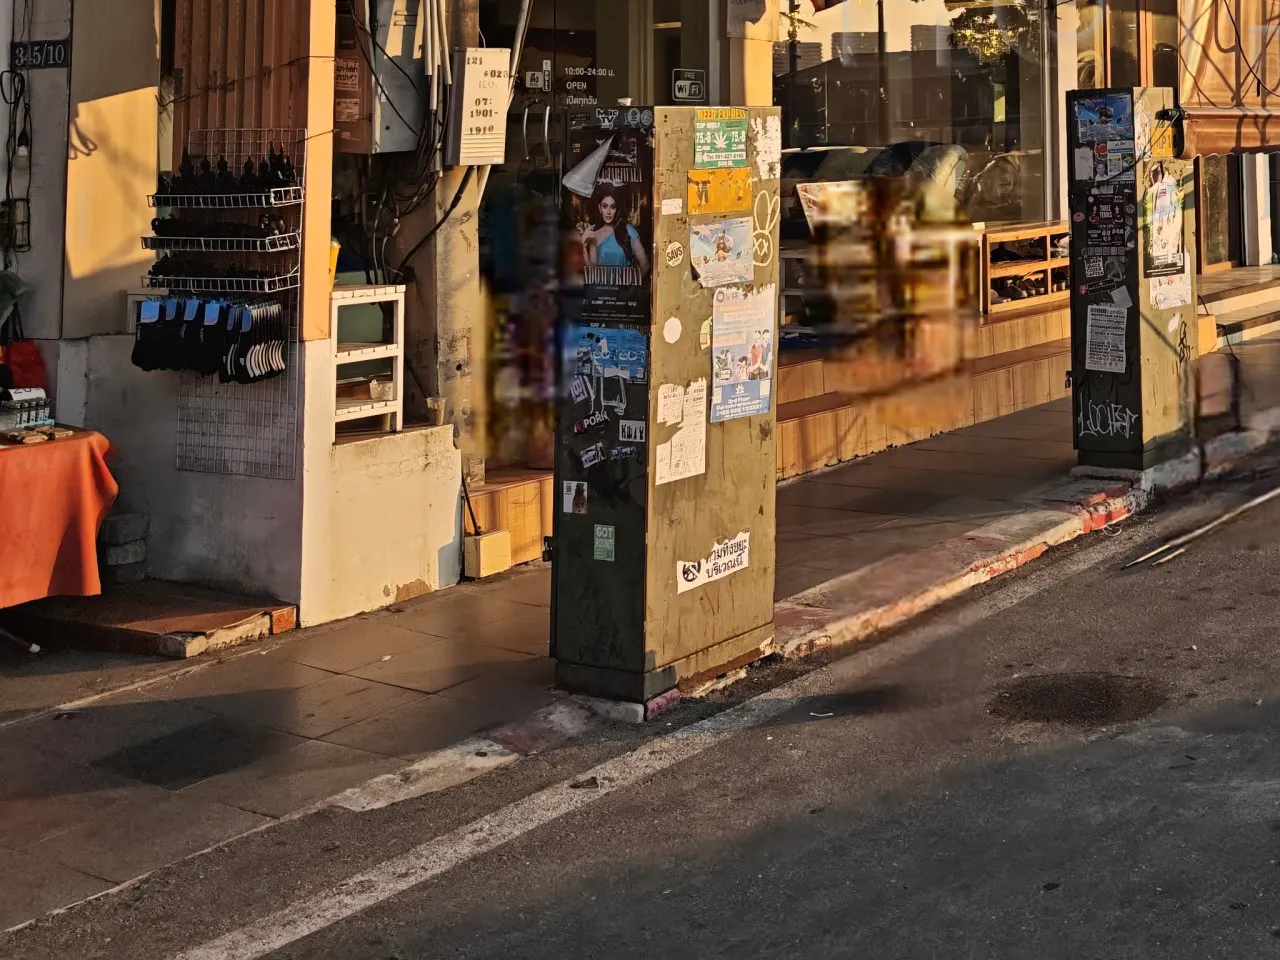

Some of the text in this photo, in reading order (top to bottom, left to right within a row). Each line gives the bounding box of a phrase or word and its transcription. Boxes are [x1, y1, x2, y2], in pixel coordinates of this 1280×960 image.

[564, 67, 607, 77] 10:00-24:00
[566, 81, 587, 90] OPEN
[566, 95, 598, 107] เปิดทุกวัน
[596, 526, 613, 538] GOT
